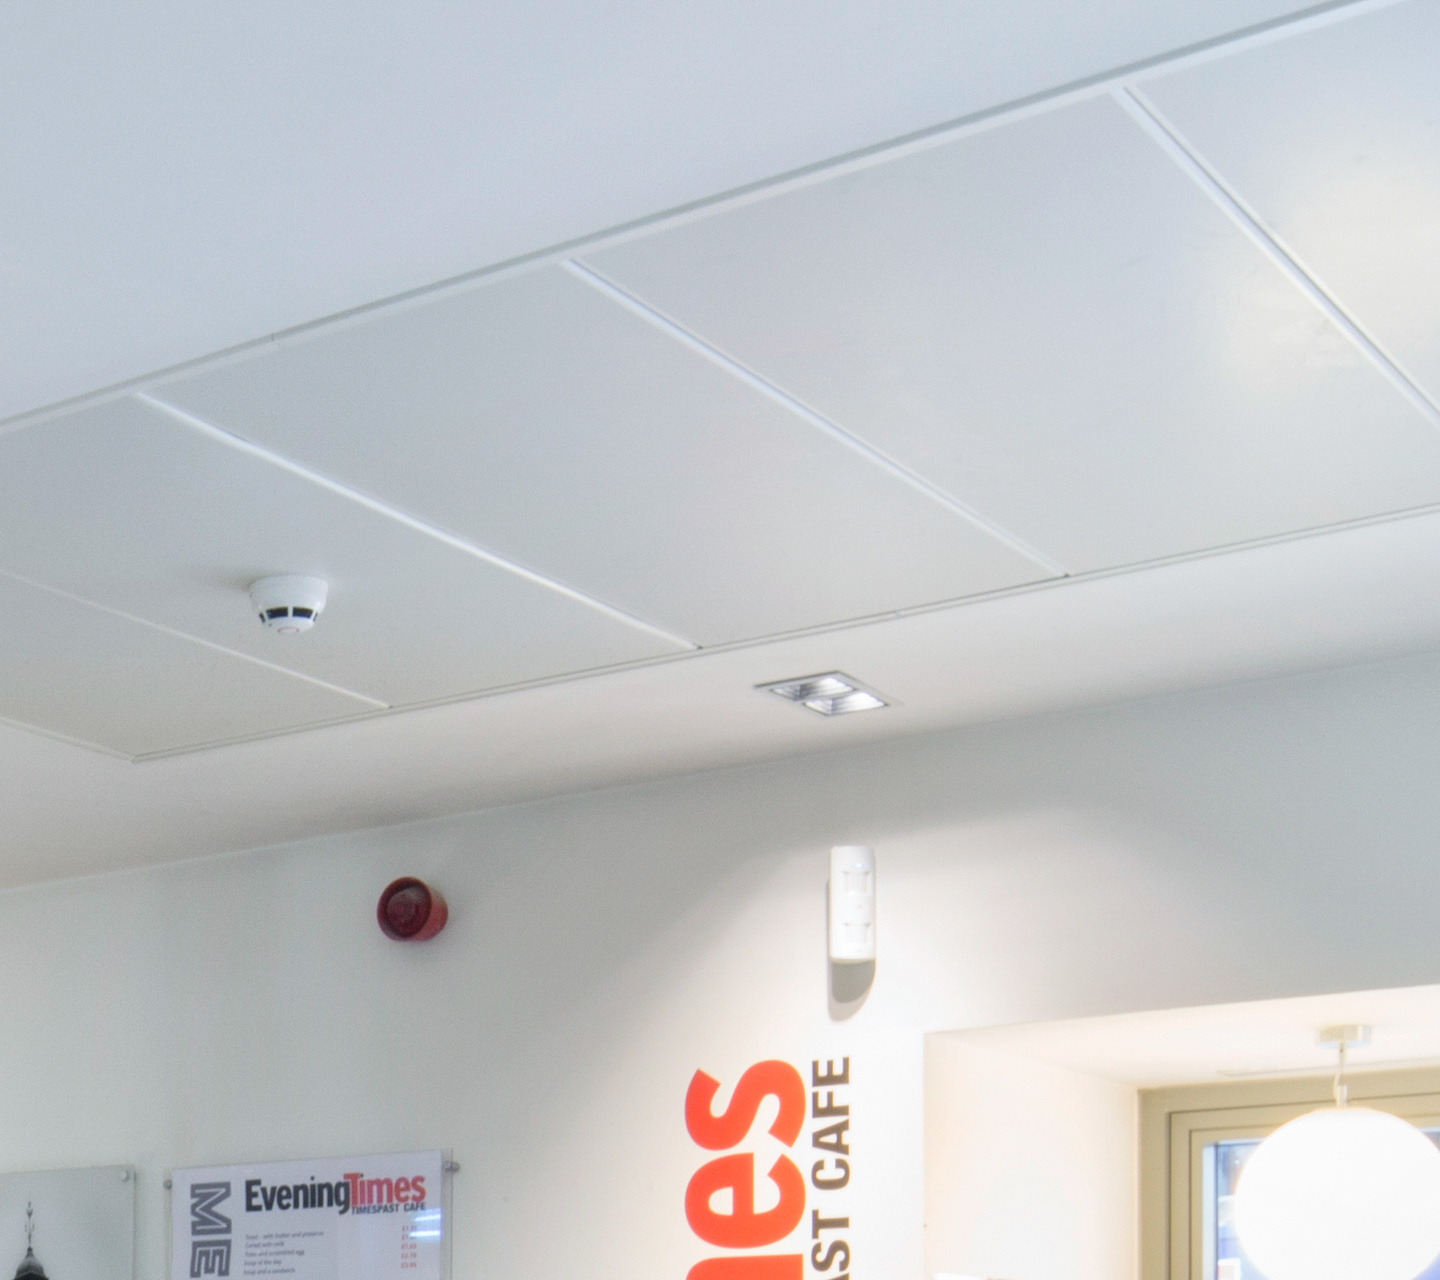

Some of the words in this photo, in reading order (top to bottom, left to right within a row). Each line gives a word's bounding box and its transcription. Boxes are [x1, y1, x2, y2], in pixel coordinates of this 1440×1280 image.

[812, 1056, 851, 1190] CAFE
[245, 1172, 427, 1215] EveningTimes
[351, 1204, 399, 1216] TIMESPAST
[404, 1201, 426, 1212] CAFE
